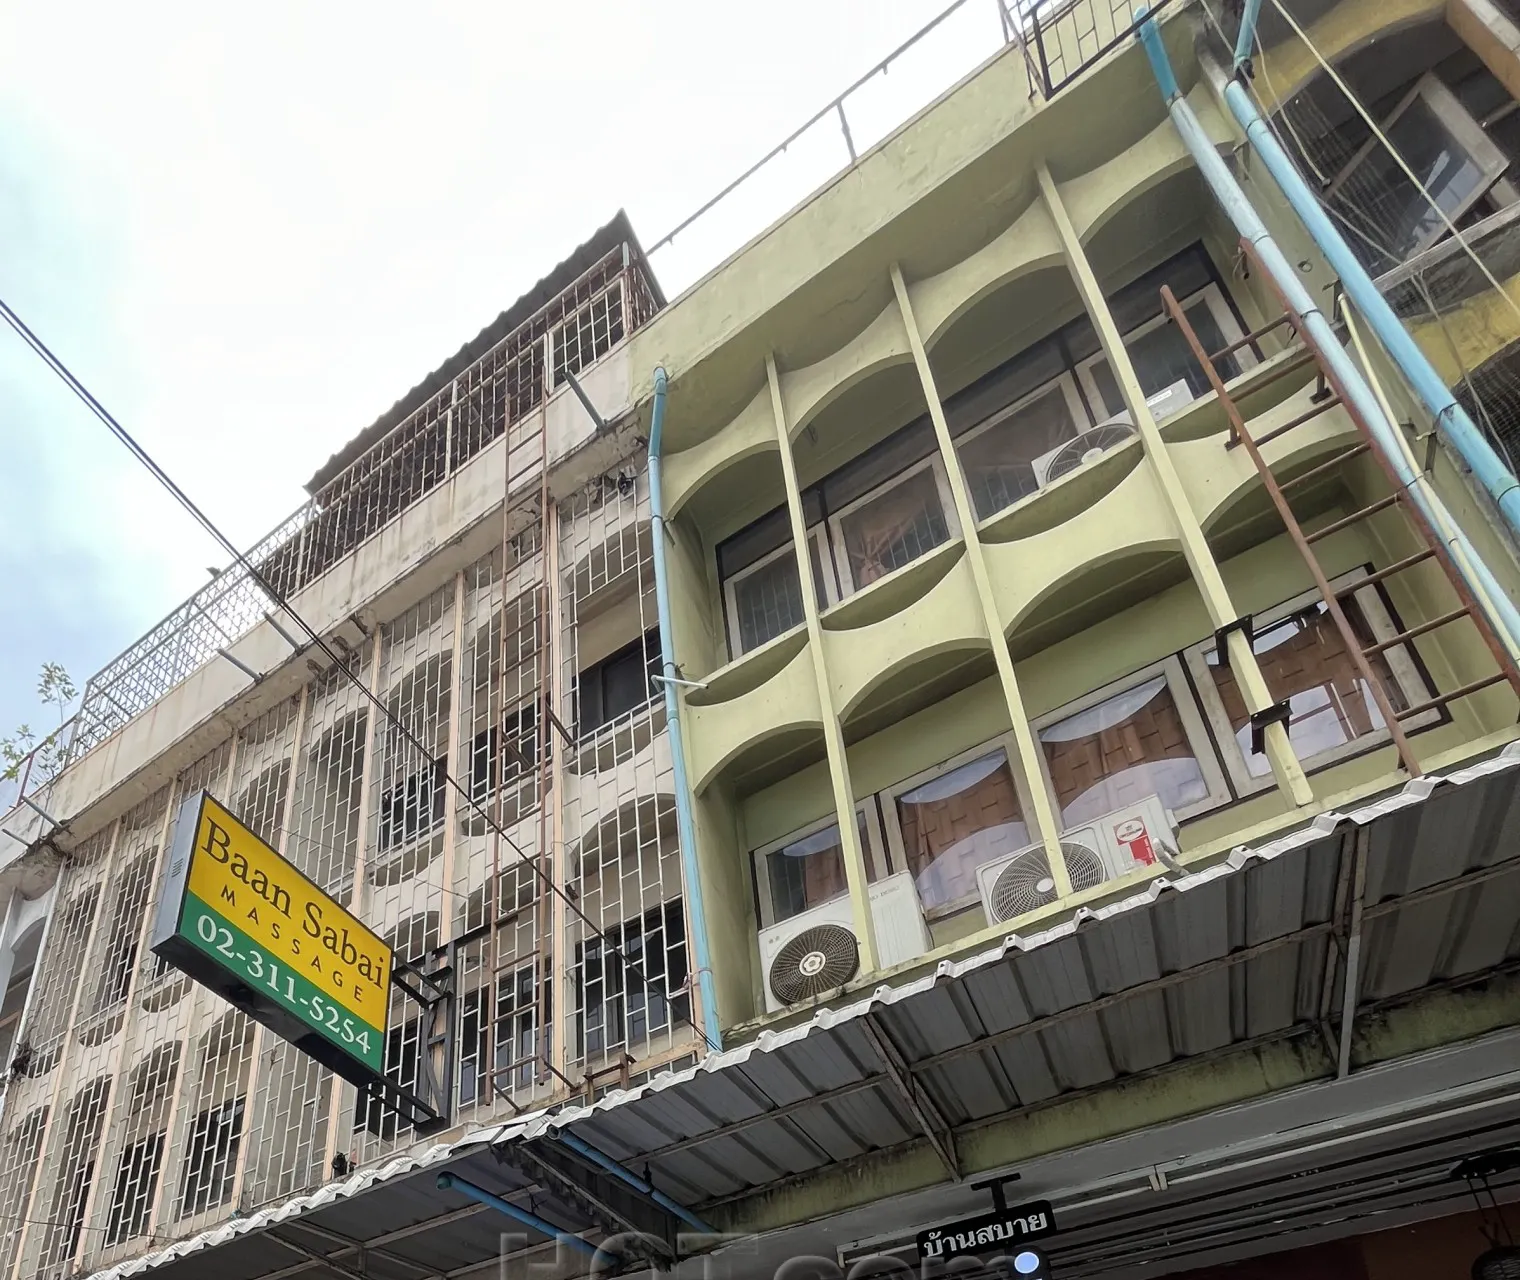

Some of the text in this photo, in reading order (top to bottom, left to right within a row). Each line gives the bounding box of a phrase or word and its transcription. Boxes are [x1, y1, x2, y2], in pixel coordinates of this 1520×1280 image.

[201, 816, 384, 990] Baan Sabai
[220, 884, 363, 1003] MASSAGE
[197, 914, 371, 1055] 02-311-5254
[923, 1212, 1048, 1258] บ้านสบาย
